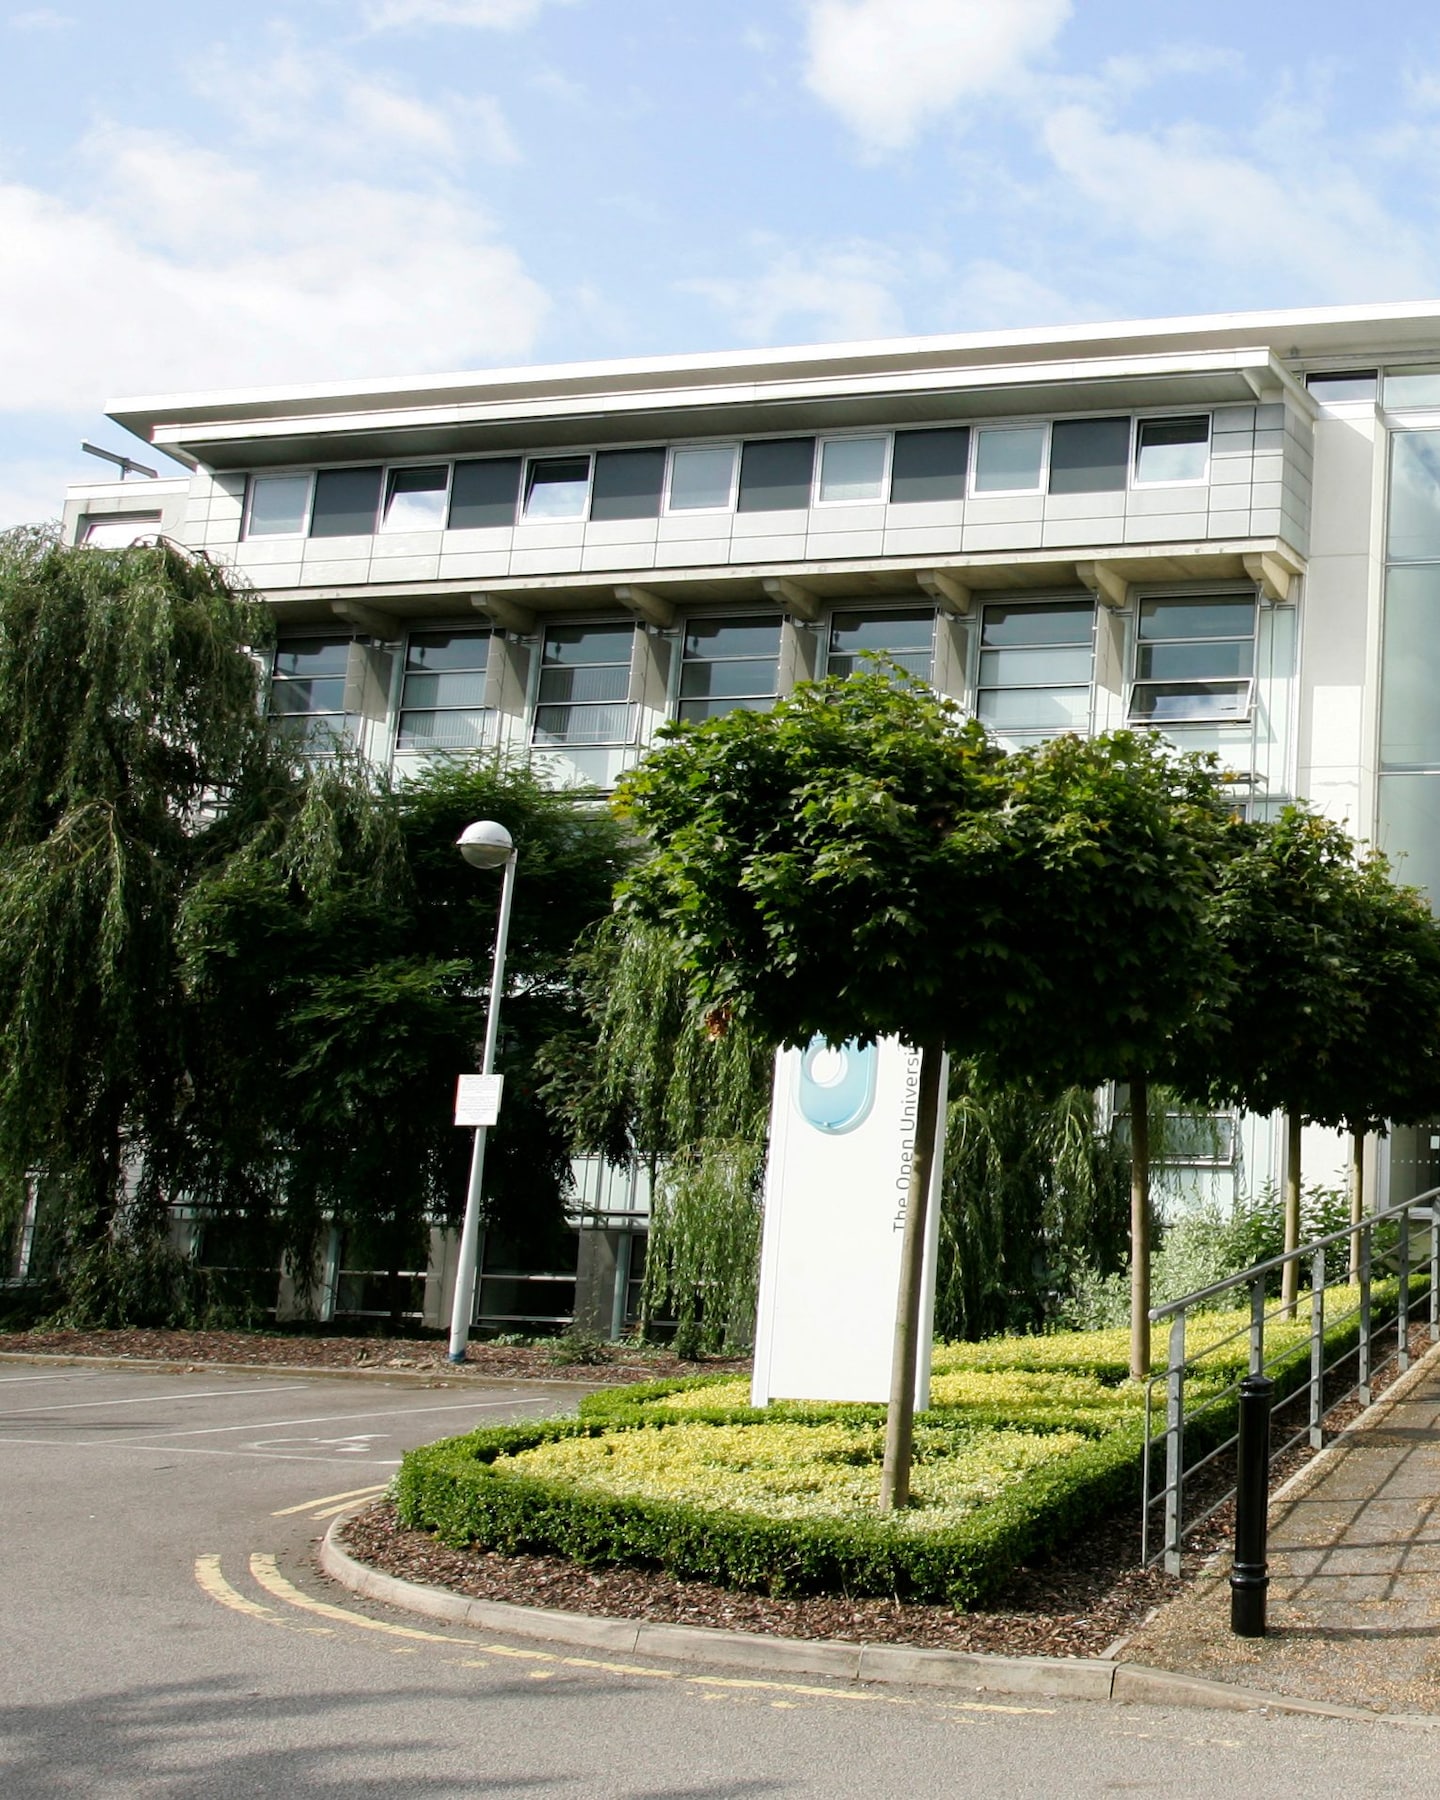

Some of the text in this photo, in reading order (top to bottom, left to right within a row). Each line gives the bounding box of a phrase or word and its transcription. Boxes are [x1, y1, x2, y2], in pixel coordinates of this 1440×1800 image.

[893, 1045, 919, 1233] The Open Universi
